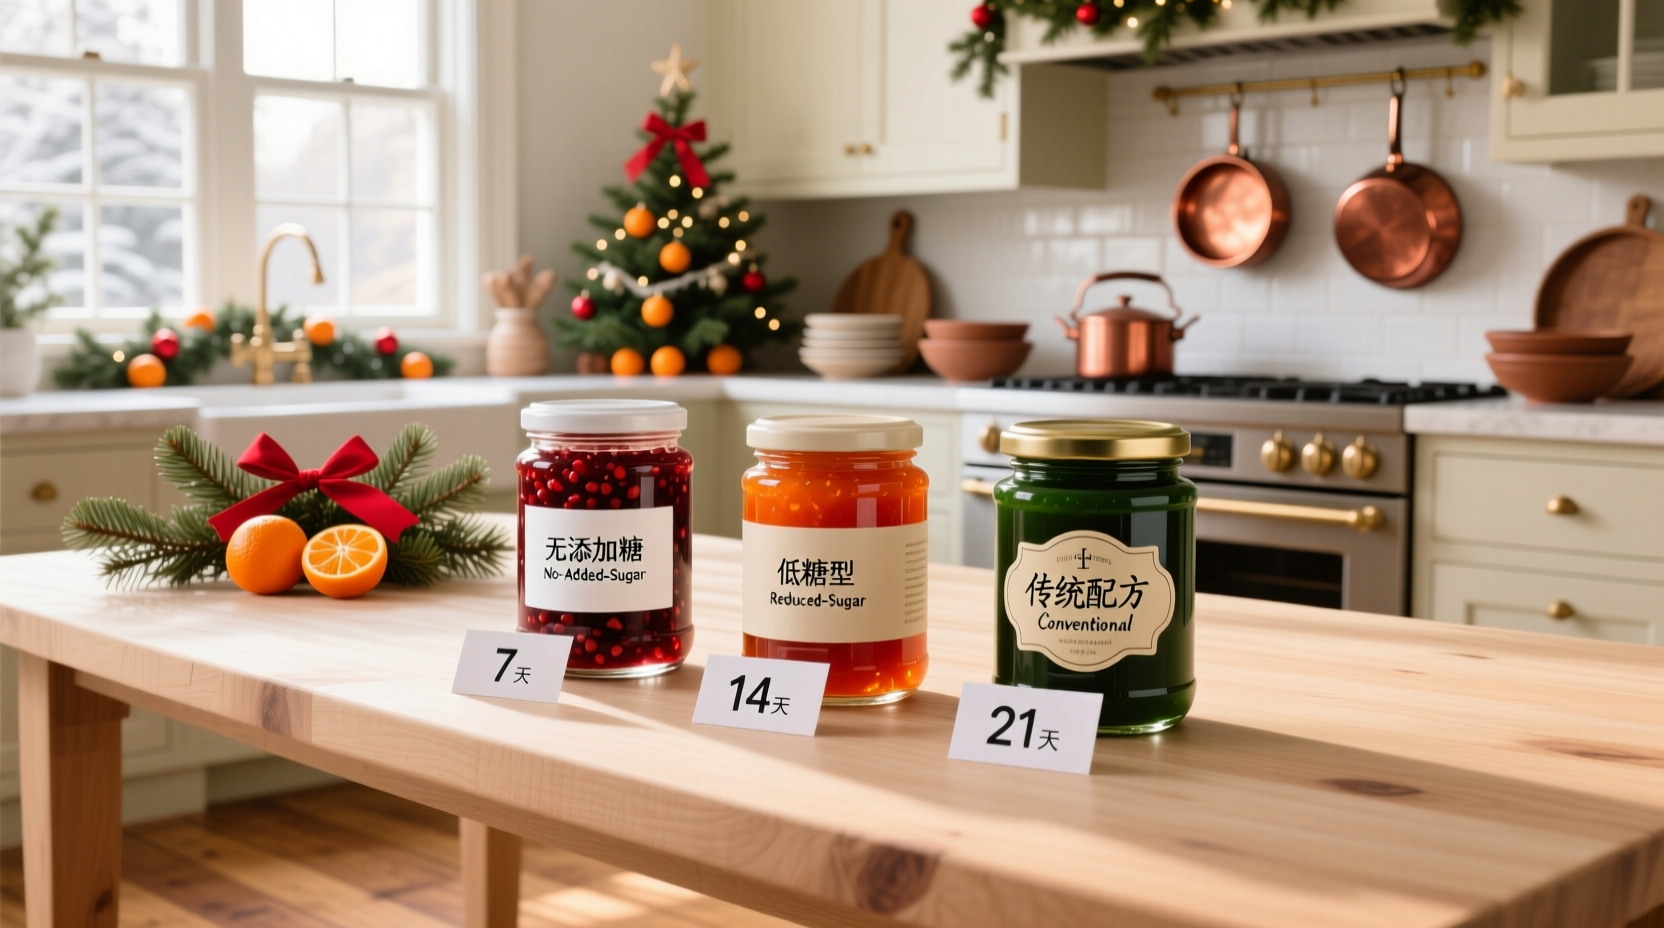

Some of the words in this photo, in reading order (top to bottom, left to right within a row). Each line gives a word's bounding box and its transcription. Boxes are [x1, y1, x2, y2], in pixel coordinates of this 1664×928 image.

[545, 535, 644, 563] 无添加糖
[544, 567, 646, 584] No-Added-Sugar
[777, 558, 855, 588] 低糖型
[770, 592, 866, 610] Reduced-Sugar
[1025, 572, 1149, 610] 传统配方
[1038, 611, 1134, 632] Conventional
